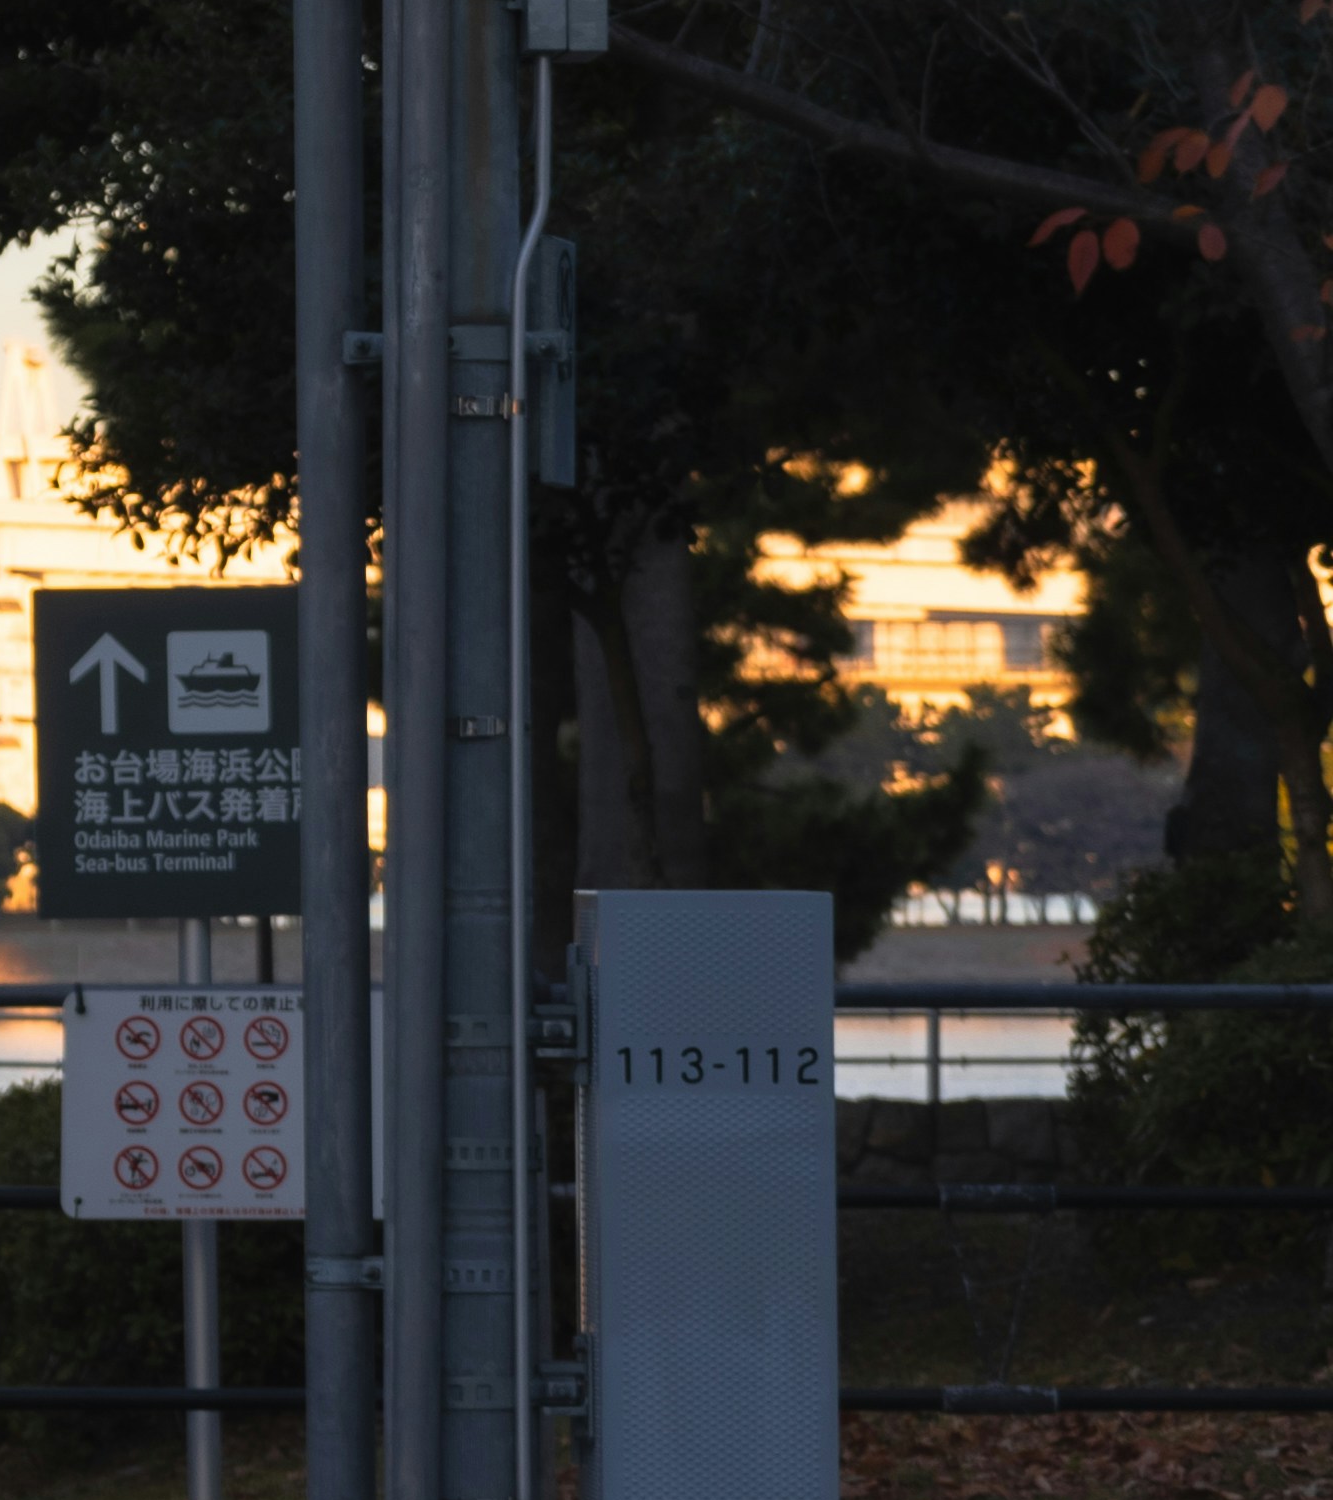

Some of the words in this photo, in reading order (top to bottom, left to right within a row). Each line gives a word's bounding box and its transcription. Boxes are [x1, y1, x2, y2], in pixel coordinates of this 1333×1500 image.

[74, 748, 301, 785] お台場海浜公
[74, 787, 301, 825] 海上バス発着
[74, 829, 140, 850] Odaiba
[146, 829, 211, 849] Marine
[217, 828, 259, 848] Park
[75, 853, 148, 873] Sea-bus
[153, 851, 235, 872] Terminal
[617, 1046, 820, 1085] 113-112
